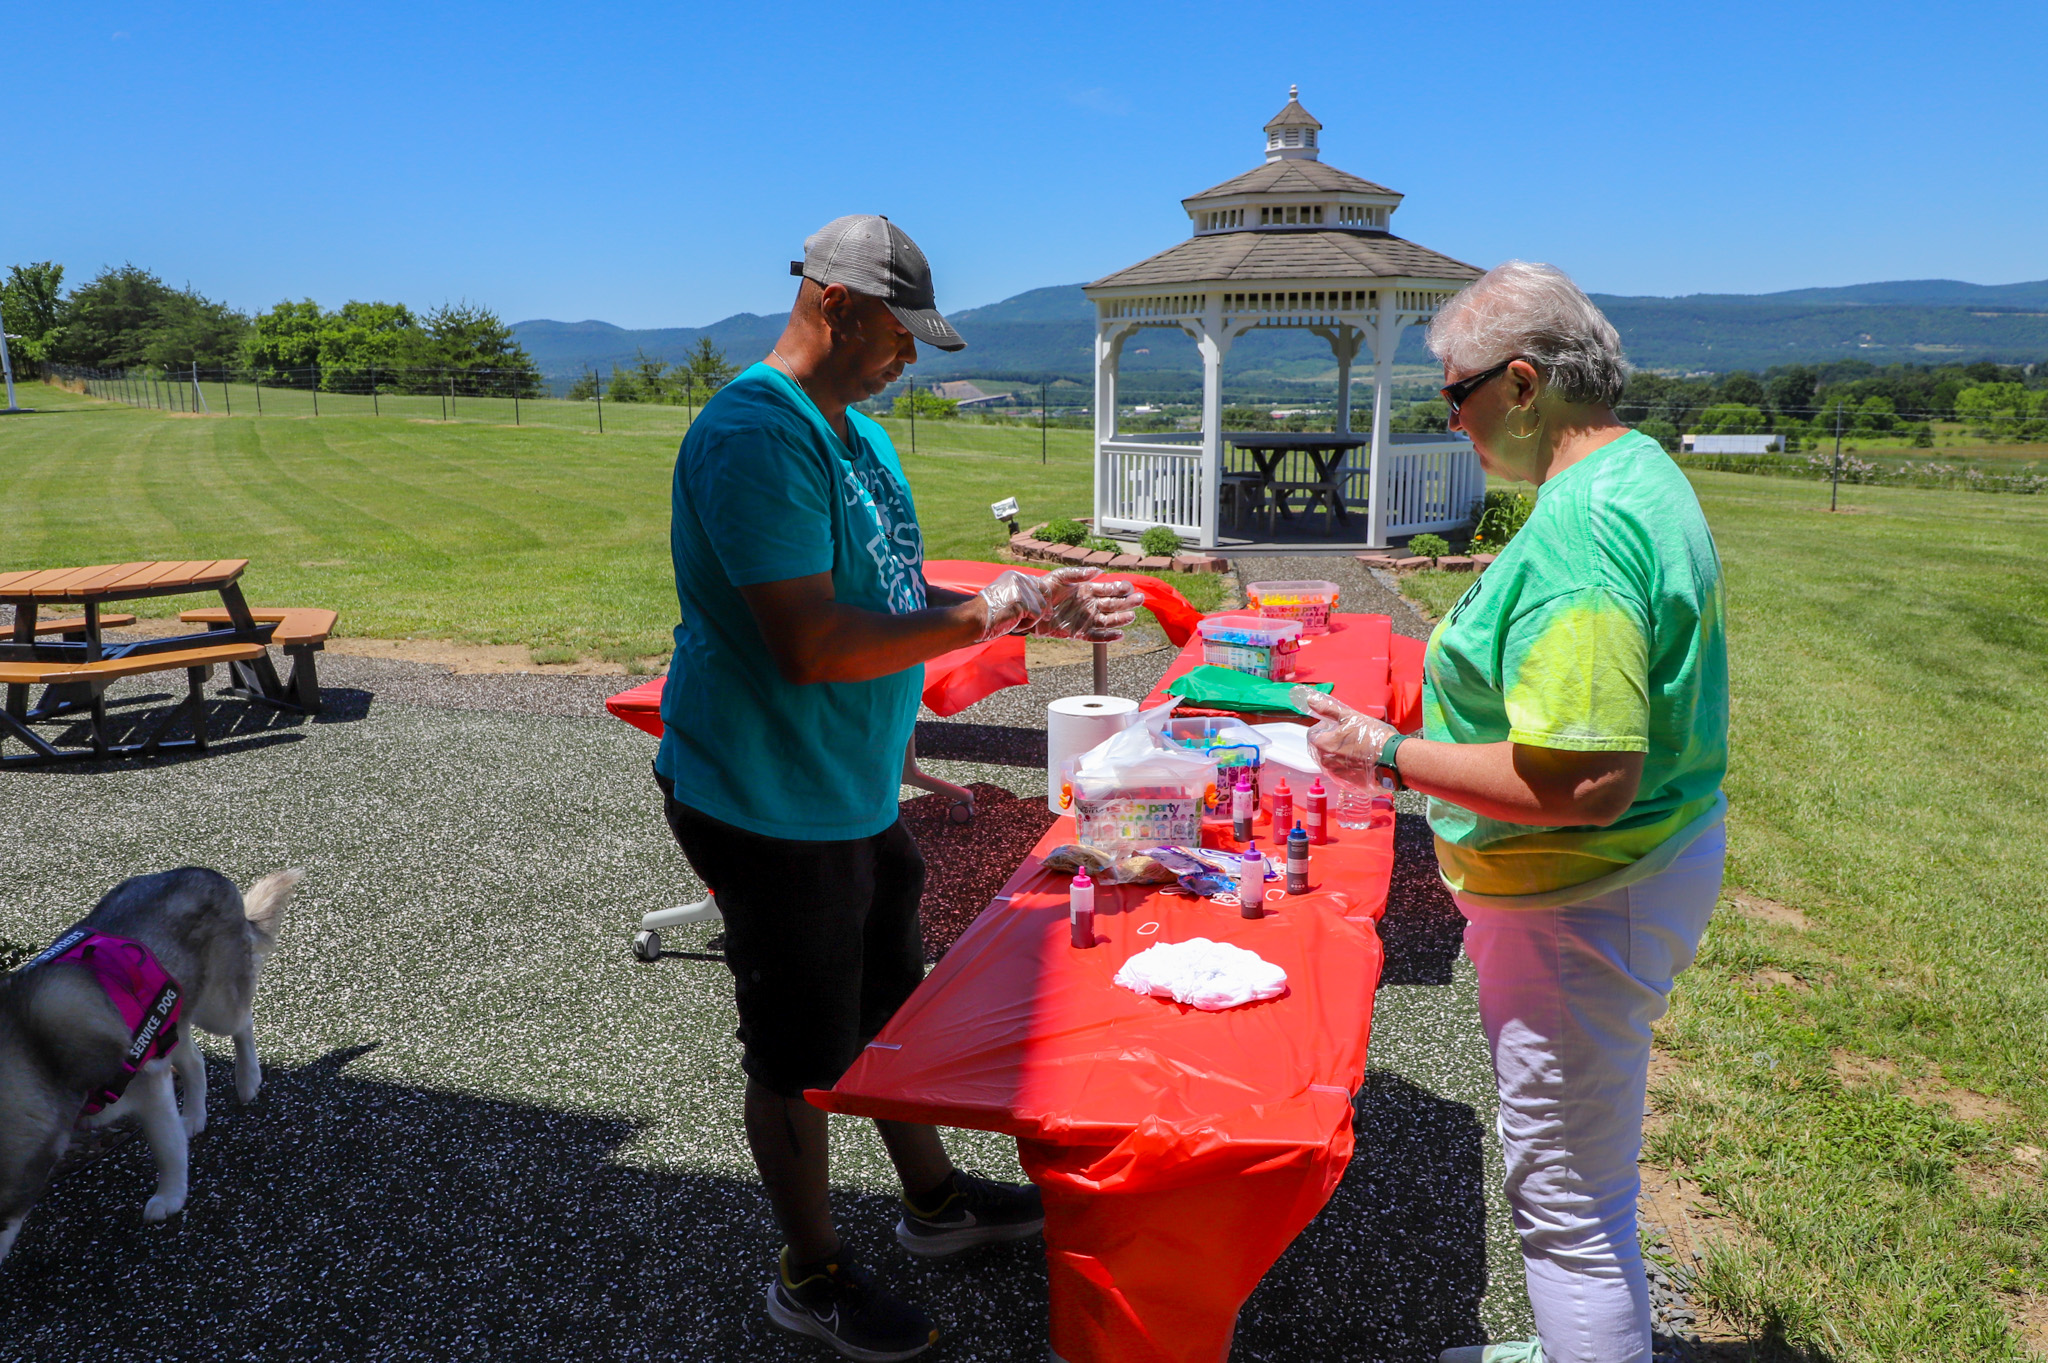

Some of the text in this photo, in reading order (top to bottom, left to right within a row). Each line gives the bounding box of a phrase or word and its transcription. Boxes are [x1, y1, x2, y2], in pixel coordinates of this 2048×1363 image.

[1149, 803, 1180, 816] party
[38, 930, 85, 960] SERVICE
[129, 988, 177, 1059] SERVICE DOG
